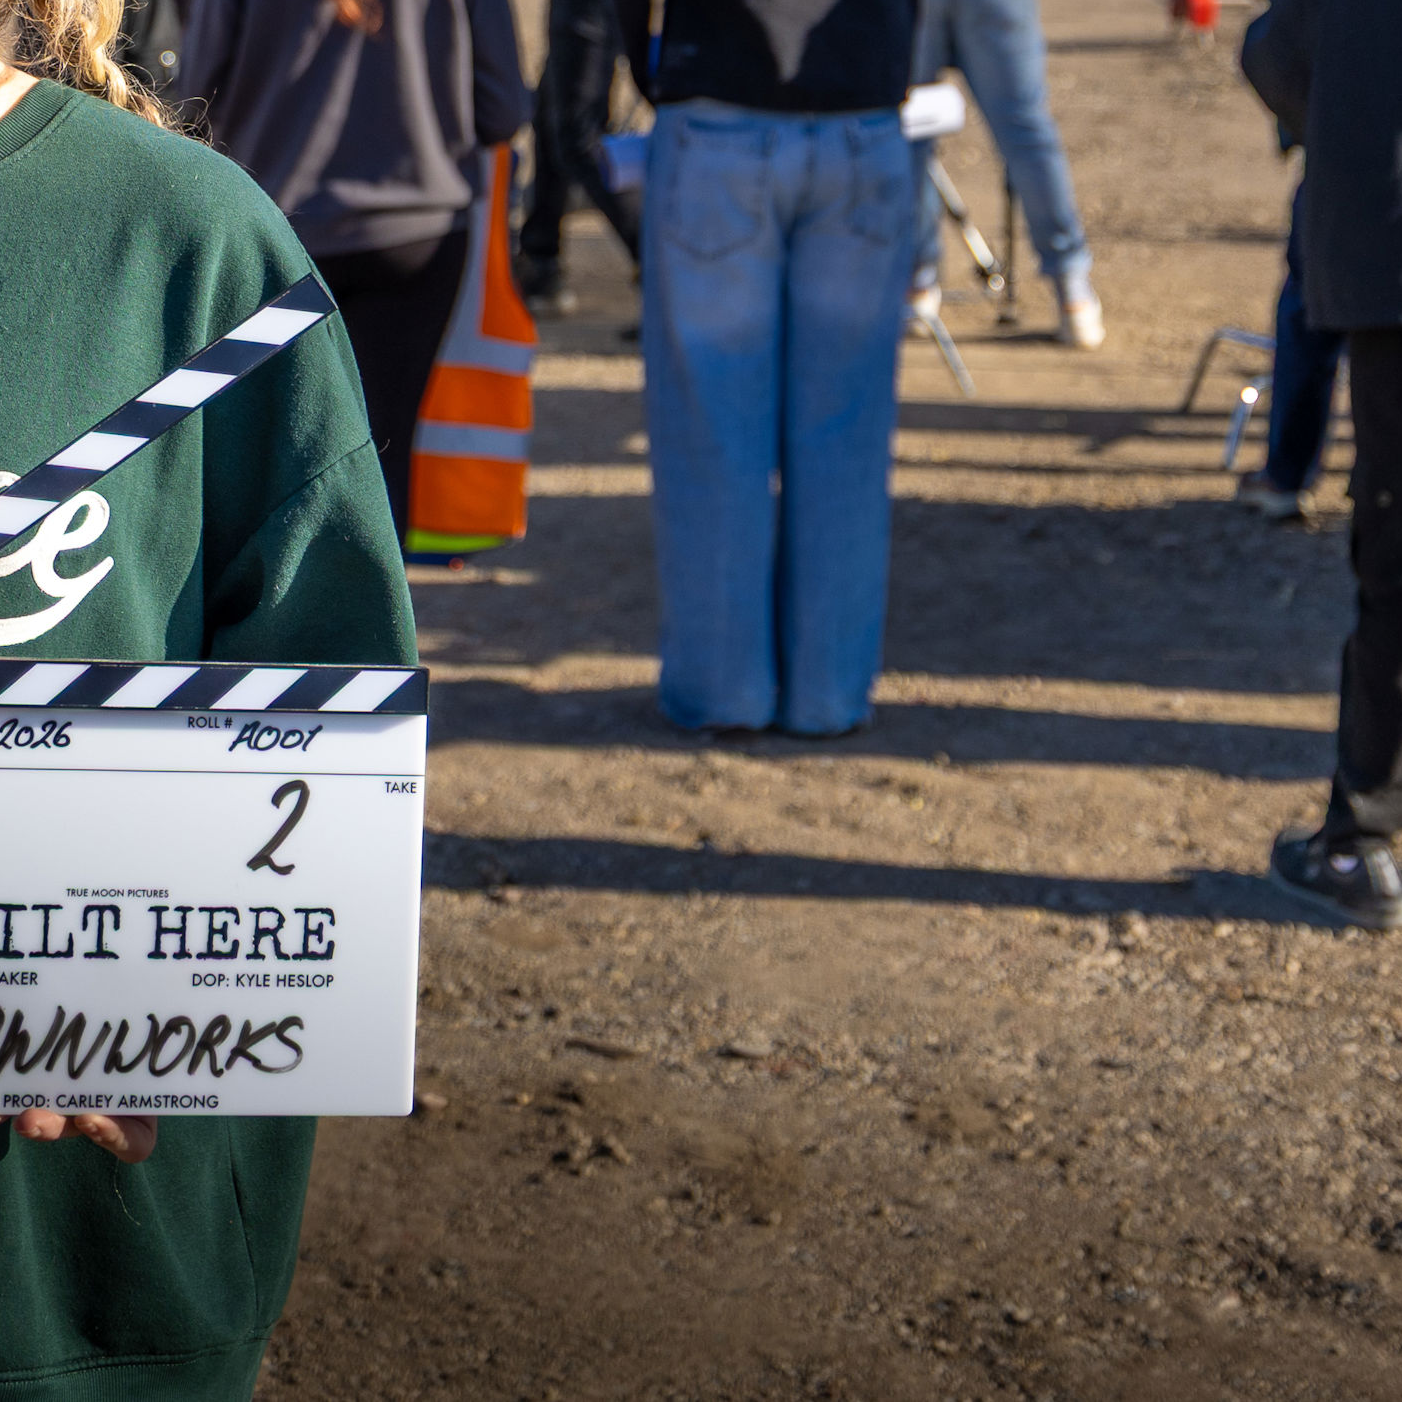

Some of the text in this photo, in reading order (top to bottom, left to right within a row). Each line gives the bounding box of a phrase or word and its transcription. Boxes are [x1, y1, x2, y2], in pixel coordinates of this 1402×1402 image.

[187, 715, 234, 729] ROLL #
[227, 719, 324, 752] A001
[384, 781, 417, 794] TAKE
[245, 778, 311, 876] 2
[65, 887, 170, 899] TRUE MOON PICTURES
[147, 904, 337, 961] HERE
[191, 972, 335, 988] DOP: KYLE HESLOP
[2, 1093, 219, 1109] PROD: CARLEY ARMSTRONG
